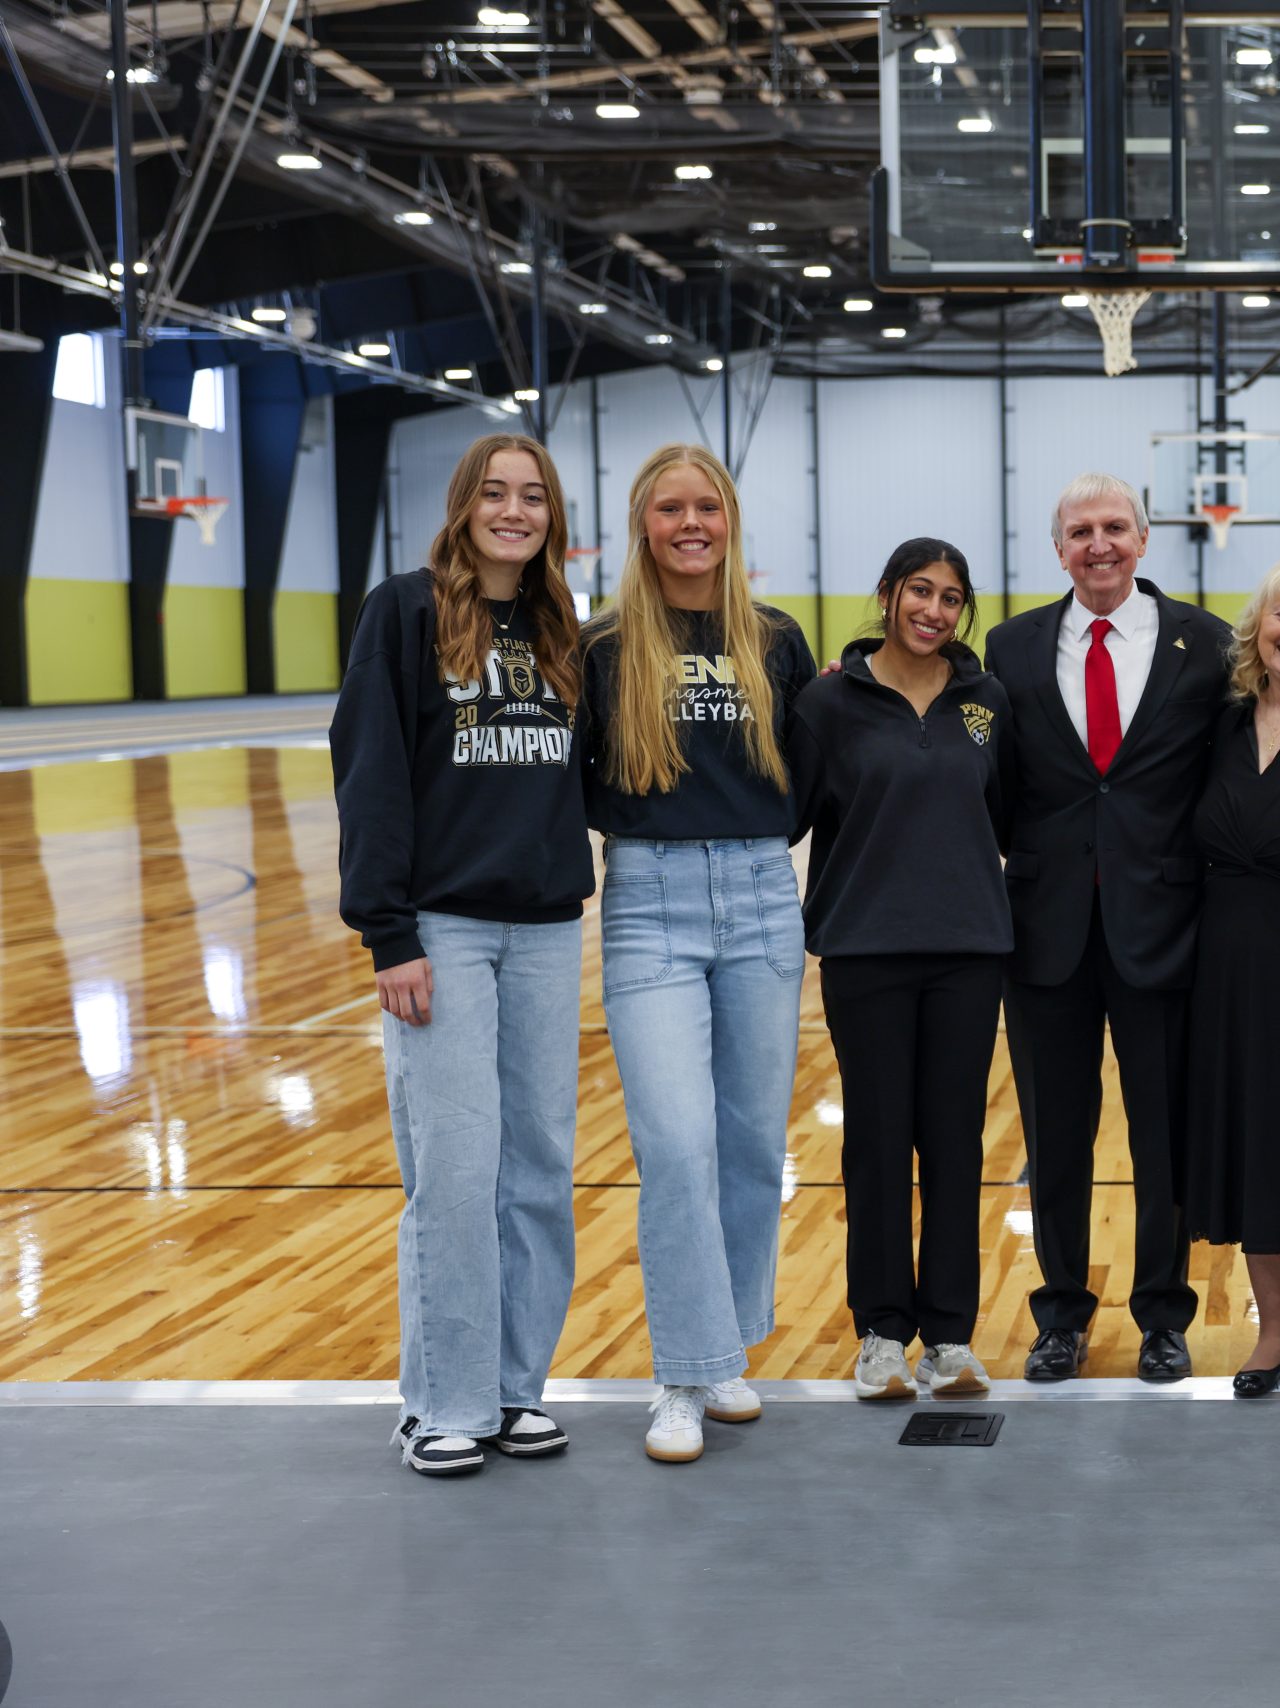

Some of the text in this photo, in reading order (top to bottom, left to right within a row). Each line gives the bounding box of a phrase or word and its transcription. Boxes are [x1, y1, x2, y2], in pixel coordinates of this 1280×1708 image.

[503, 637, 527, 652] FLAG
[454, 704, 478, 729] 20
[667, 702, 755, 722] LLEYBA
[959, 703, 995, 723] PENN
